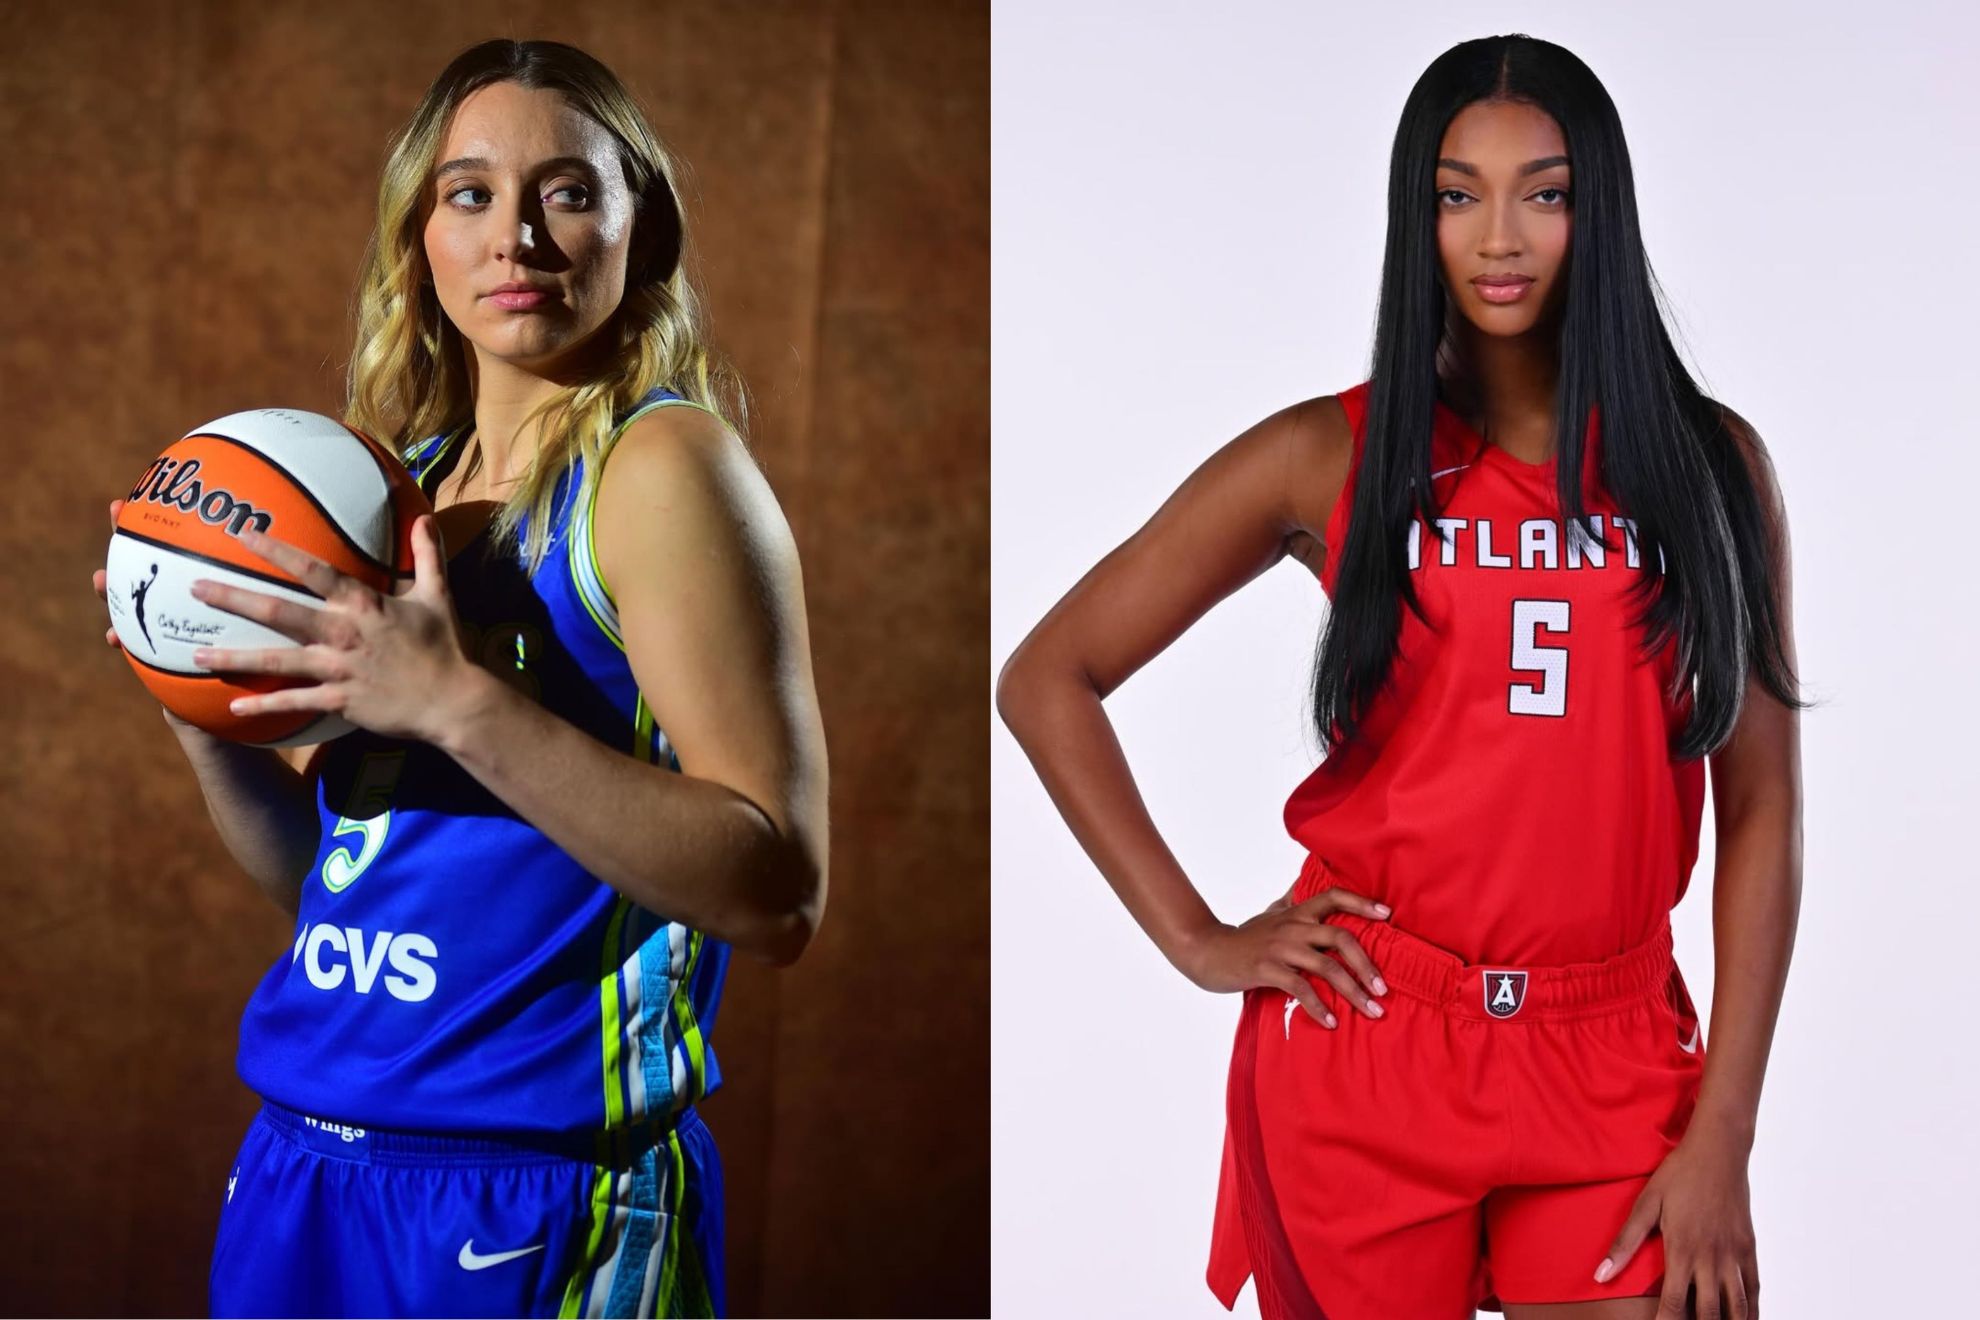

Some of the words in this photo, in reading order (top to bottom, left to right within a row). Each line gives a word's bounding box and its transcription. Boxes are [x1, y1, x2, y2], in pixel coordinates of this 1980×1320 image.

[1407, 513, 1667, 576] TLANT
[1508, 598, 1571, 717] 5
[304, 922, 439, 1003] CVS
